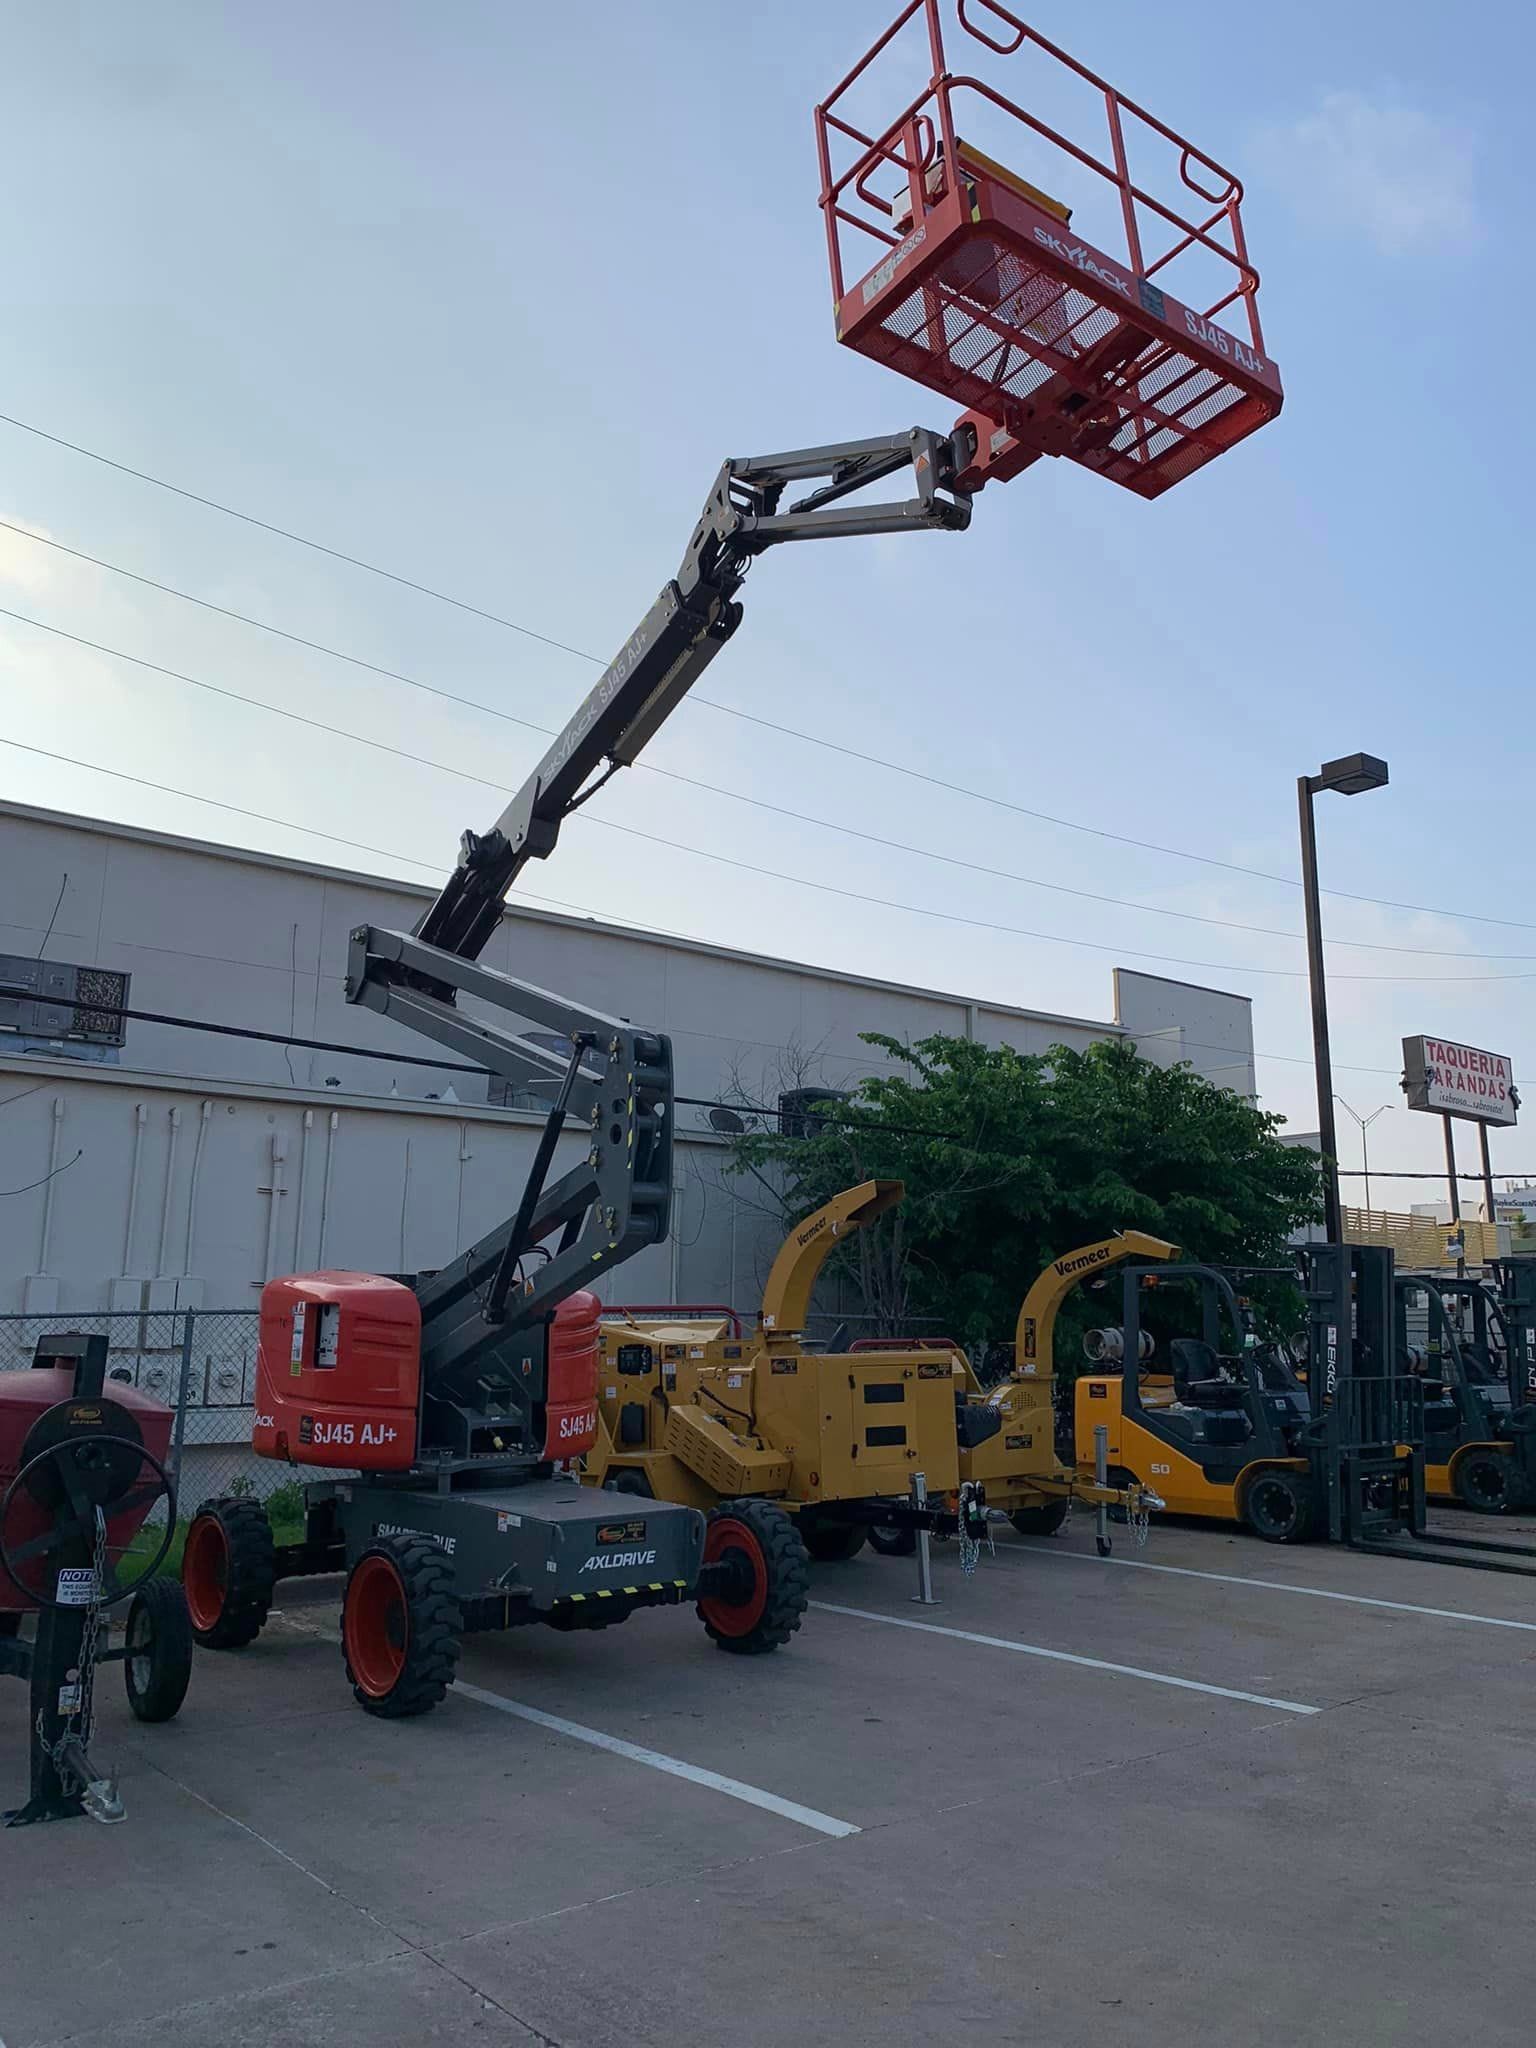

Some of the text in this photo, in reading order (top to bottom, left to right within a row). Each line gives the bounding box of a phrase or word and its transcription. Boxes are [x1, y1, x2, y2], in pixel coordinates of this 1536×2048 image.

[1032, 226, 1133, 297] SKYJACK
[1184, 310, 1265, 374] SJ45 AJ+
[542, 631, 649, 784] SKYJACK SJ45 AJ+
[1426, 1040, 1506, 1079] TAQUERIA
[1434, 1066, 1506, 1101] ARANDAS
[796, 1214, 826, 1247] Vermeer
[1053, 1247, 1110, 1276] Vermeer
[313, 1422, 355, 1444] SJ45
[360, 1423, 398, 1445] AJ+
[560, 1415, 585, 1438] SJ45
[578, 1549, 657, 1574] AXLDRIVE
